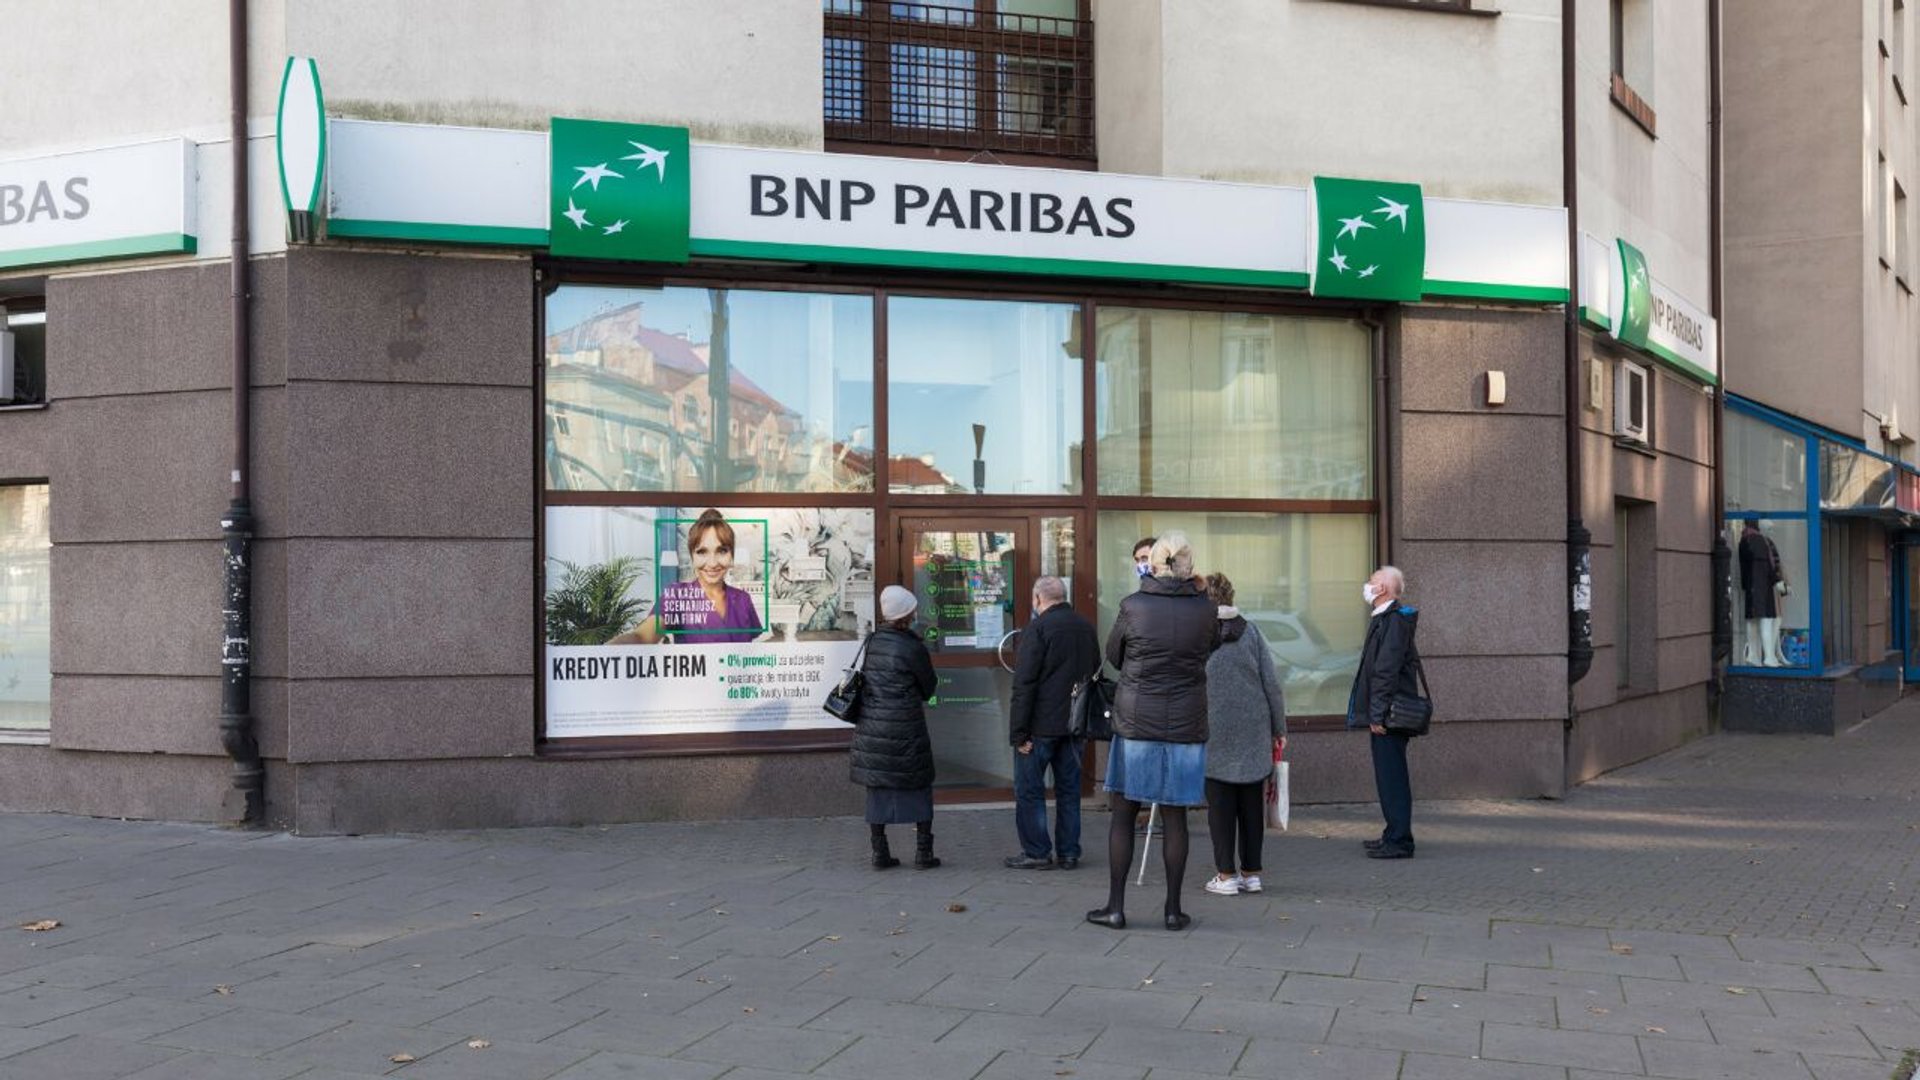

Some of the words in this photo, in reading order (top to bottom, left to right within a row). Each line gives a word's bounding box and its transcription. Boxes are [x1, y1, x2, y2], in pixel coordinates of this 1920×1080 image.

[0, 177, 90, 226] BAS
[750, 174, 875, 222] BNP
[894, 183, 1135, 239] PARIBAS
[1651, 295, 1665, 327] NP
[1666, 303, 1704, 351] PARIBAS
[664, 587, 676, 599] NA
[664, 599, 716, 612] SCENARIUSZ
[664, 612, 680, 625] DLA
[681, 612, 708, 625] FIRMY
[552, 656, 621, 680] KREDYT
[626, 655, 659, 679] DLA
[663, 654, 707, 678] FIRM
[727, 653, 741, 667] 0%
[742, 653, 777, 668] prowizji
[727, 686, 739, 699] do
[740, 685, 759, 699] 80%
